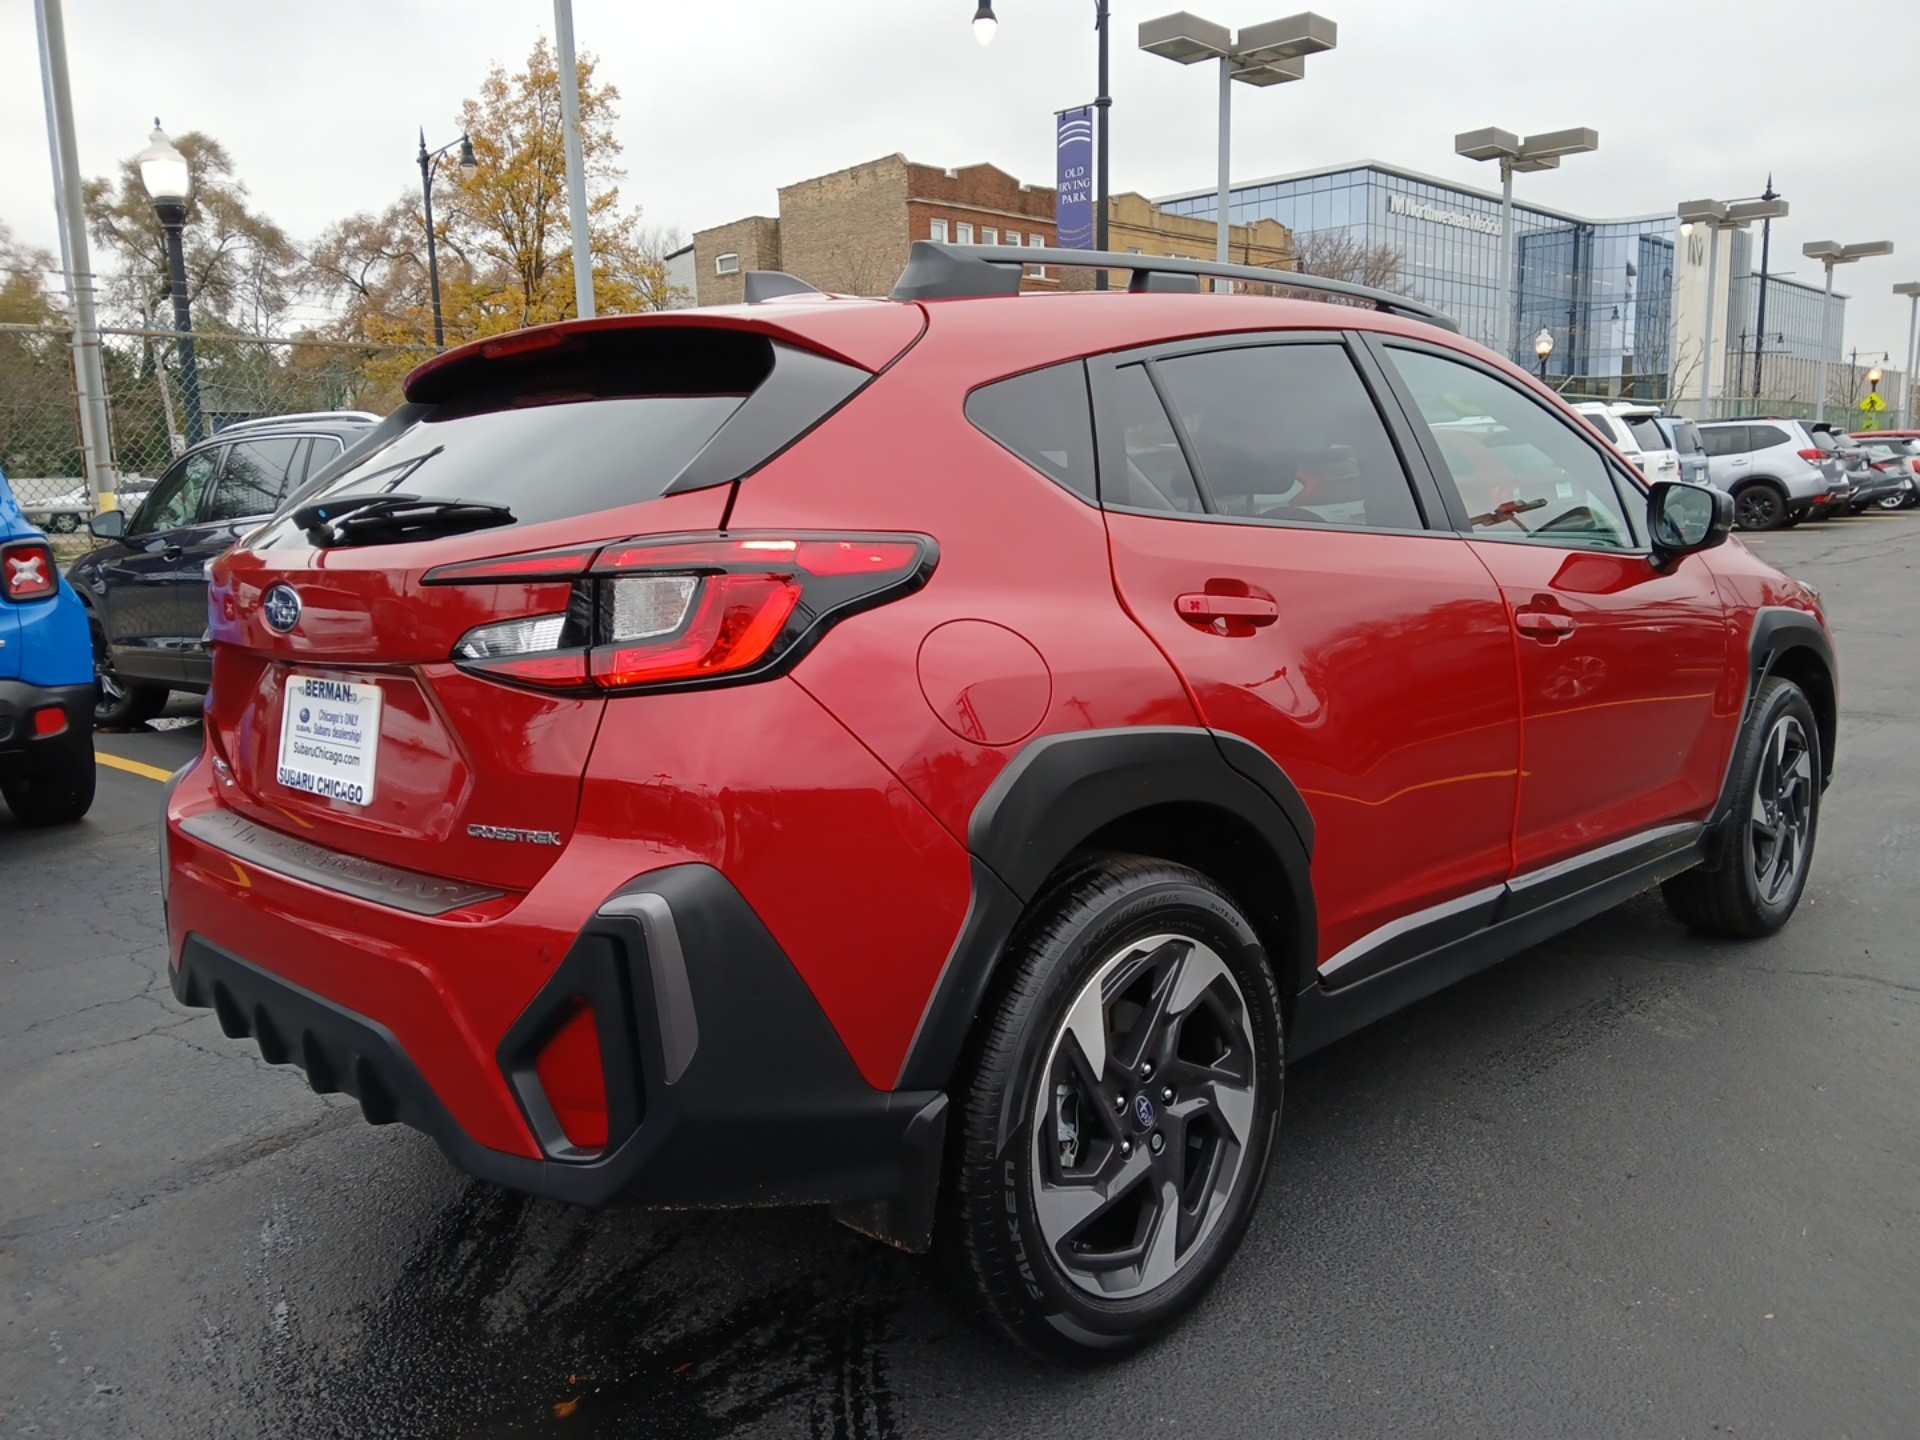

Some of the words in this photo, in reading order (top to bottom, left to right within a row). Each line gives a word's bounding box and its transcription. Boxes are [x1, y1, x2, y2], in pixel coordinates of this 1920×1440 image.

[1065, 166, 1084, 179] OLD
[1058, 177, 1091, 193] IRVING
[1061, 190, 1087, 205] PARK
[1405, 198, 1470, 230] Northwestern
[305, 679, 351, 702] BERMAN
[313, 723, 331, 737] Subaru
[344, 712, 359, 726] ONLY
[294, 741, 361, 766] SubaruChicago.com
[279, 767, 315, 791] SUBARU
[317, 776, 363, 803] CHICAGO
[467, 823, 562, 846] CROSSTREK
[1003, 1160, 1045, 1302] FALKEN
